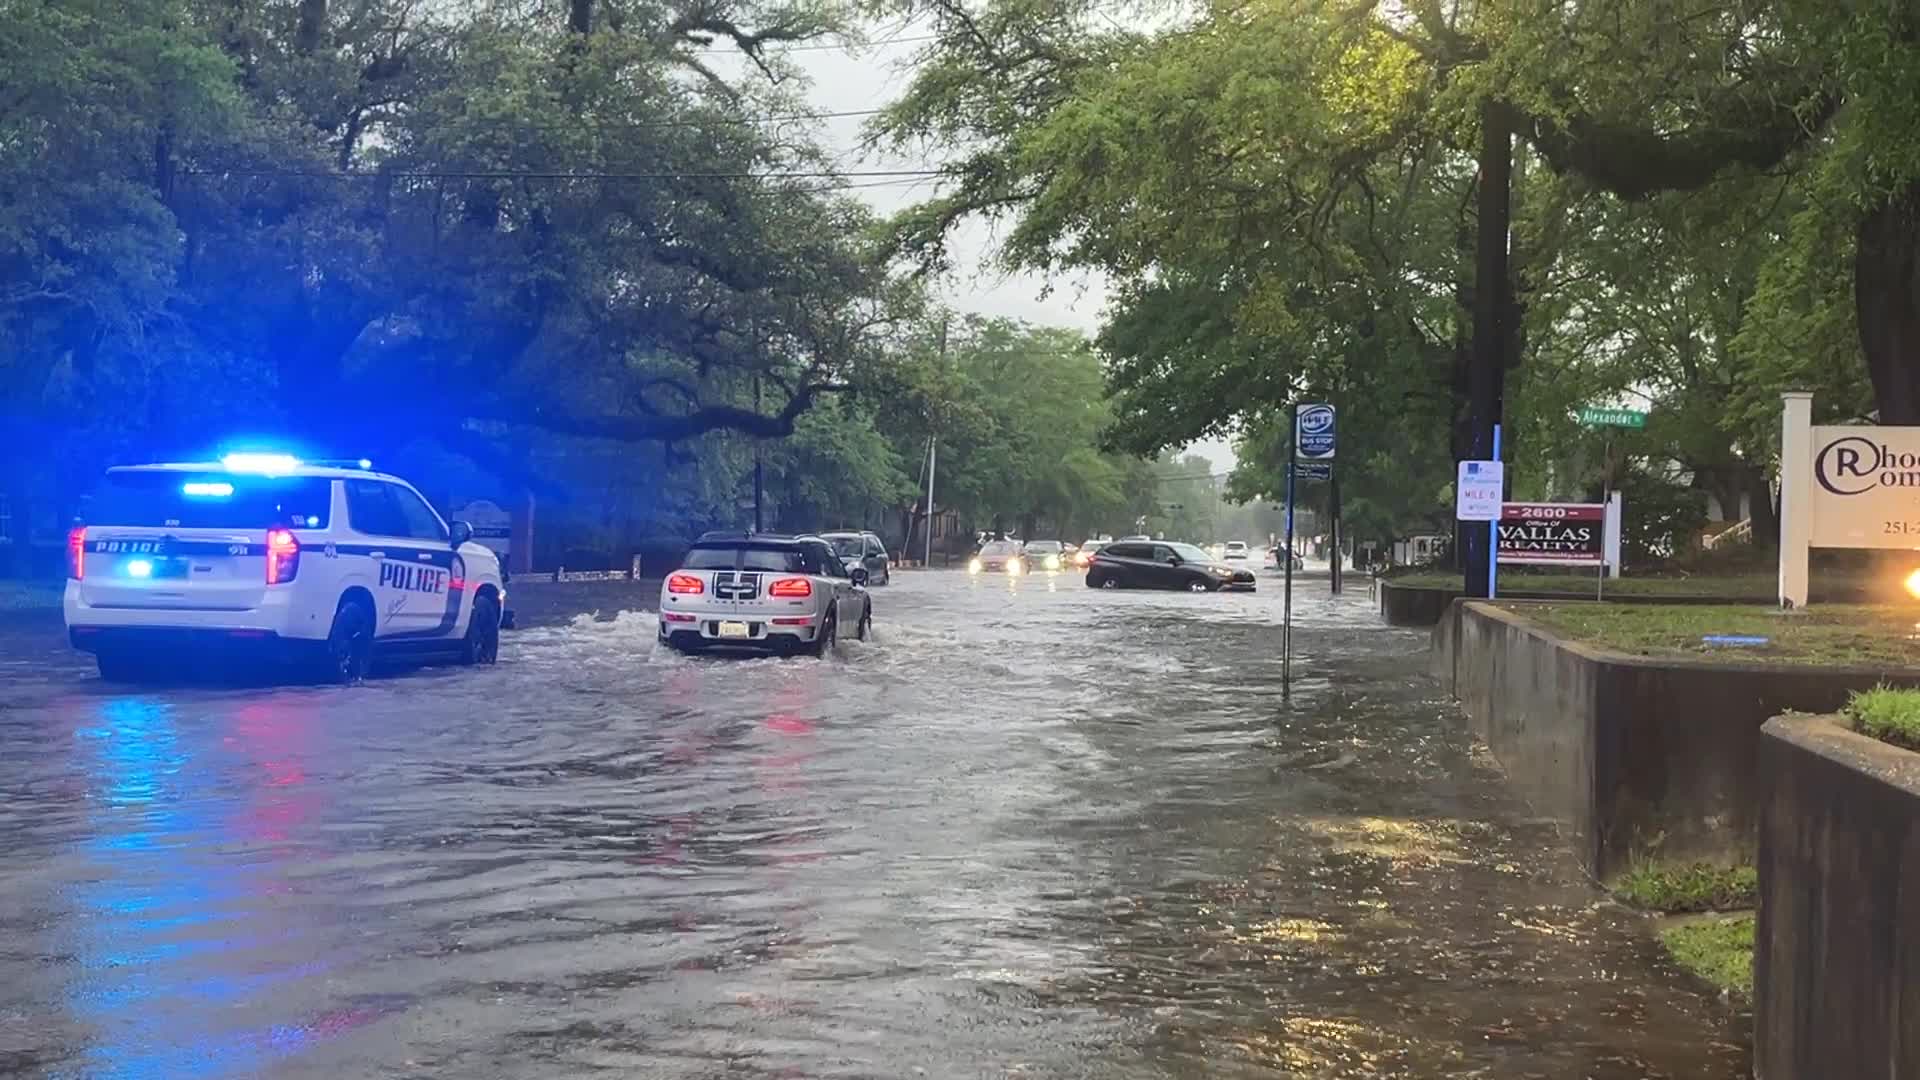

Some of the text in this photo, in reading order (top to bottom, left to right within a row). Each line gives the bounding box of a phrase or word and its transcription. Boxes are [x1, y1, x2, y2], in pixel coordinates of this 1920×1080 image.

[1583, 410, 1632, 424] Alexander
[1521, 507, 1566, 518] 2600
[1498, 526, 1591, 541] VALLAS
[96, 541, 165, 553] POLICE
[1500, 541, 1580, 550] REALTY
[379, 562, 447, 593] POLICE
